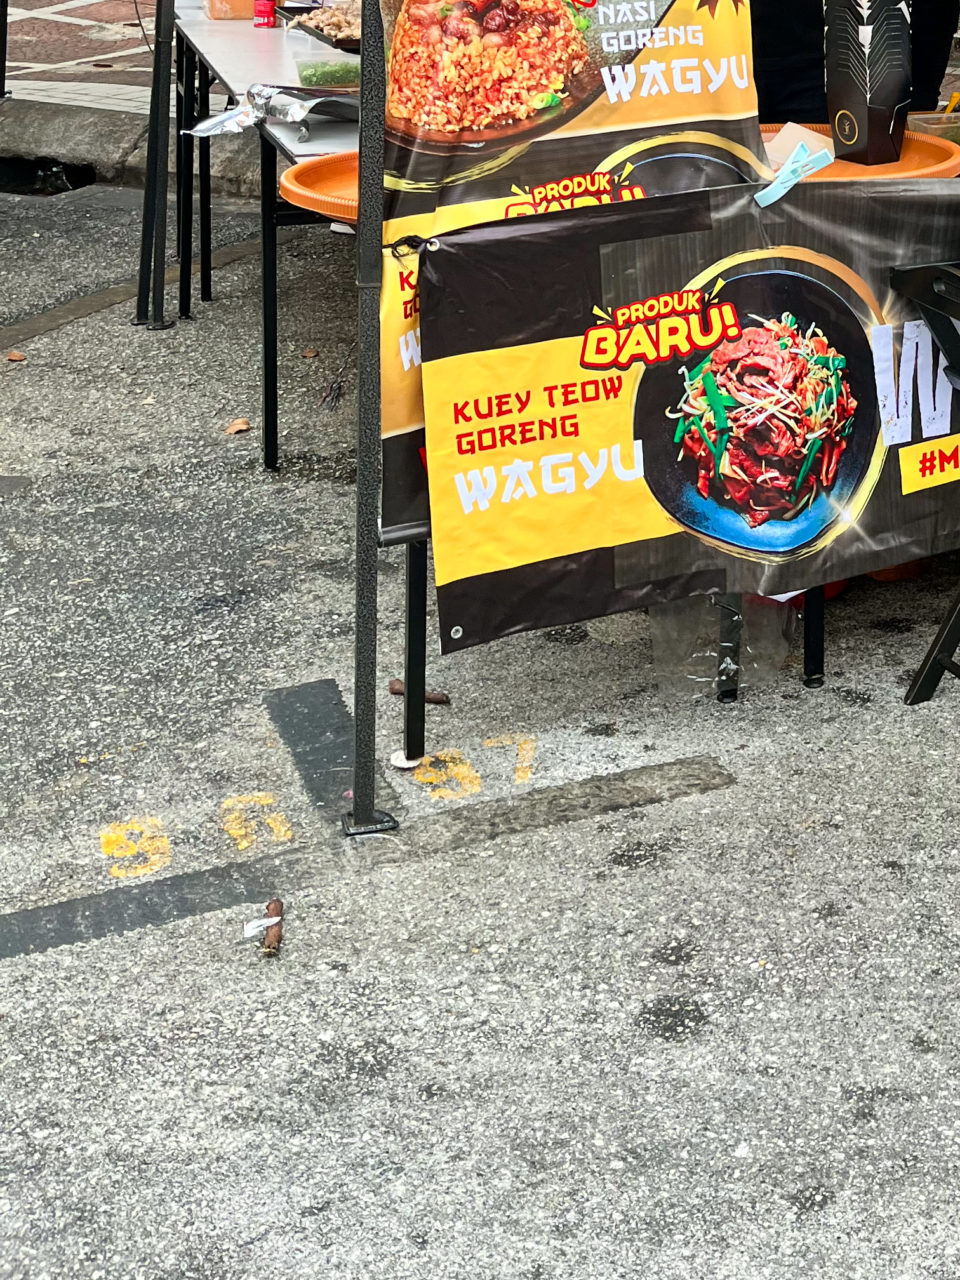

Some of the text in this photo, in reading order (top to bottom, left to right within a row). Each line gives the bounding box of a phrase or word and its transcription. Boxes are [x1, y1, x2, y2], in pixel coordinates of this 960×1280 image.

[599, 0, 656, 21] NASI
[601, 24, 704, 53] GORENG
[600, 54, 749, 106] WAGYU
[533, 173, 611, 204] PRODUK
[617, 290, 700, 326] PRODUK
[582, 304, 737, 366] BARU!
[453, 375, 624, 425] KUEY TEOW
[455, 413, 580, 456] GORENG
[453, 439, 644, 514] WAGYU
